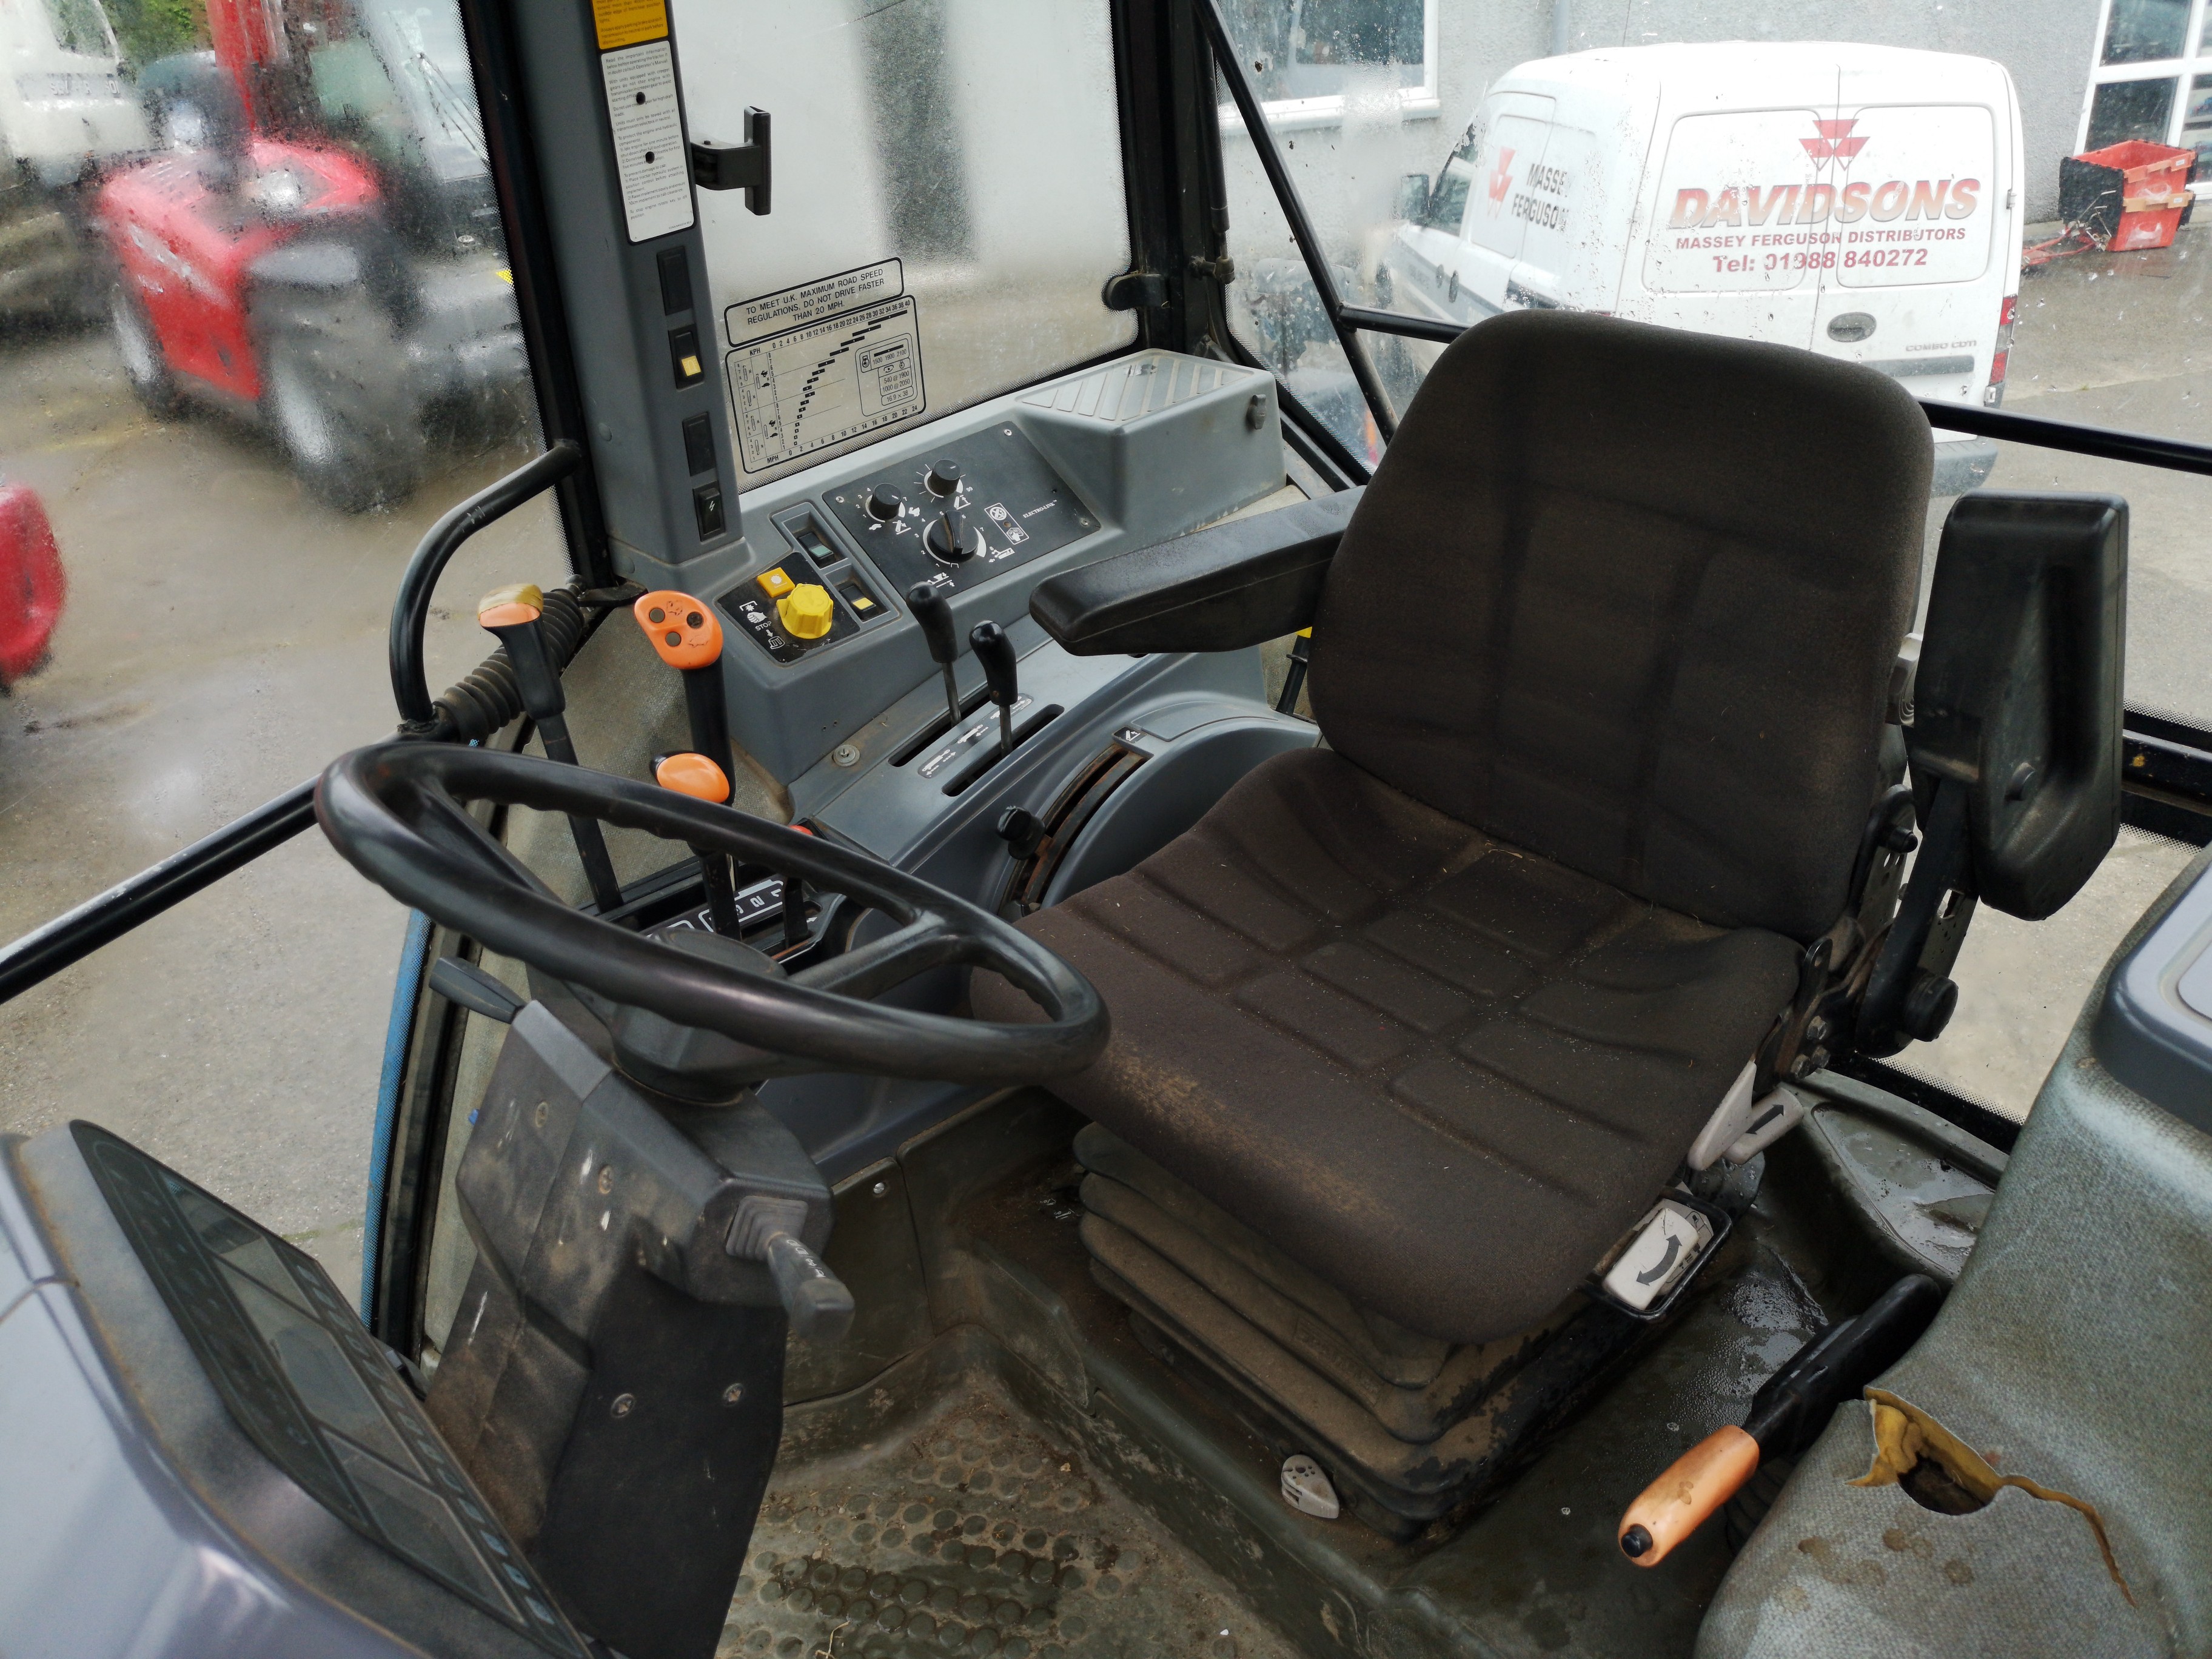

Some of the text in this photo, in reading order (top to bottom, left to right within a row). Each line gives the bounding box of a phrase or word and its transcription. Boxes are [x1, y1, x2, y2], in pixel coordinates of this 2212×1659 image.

[1526, 164, 1569, 196] MASSE
[1667, 178, 1981, 230] DAVIDSONS
[1676, 228, 1966, 249] MASSEY FERGUSON DISTRIBUTORS
[1714, 248, 1928, 273] Tel: 01988 840272
[746, 269, 883, 315] TO MEET U.K. MAXIMUM ROAD SPEED
[748, 278, 884, 325] REGULATIONS, DO NOT DRIVE FASTER
[793, 300, 845, 321] THAN 20 MPH.
[749, 347, 760, 356] KPH
[1906, 343, 1949, 352] COMBO
[899, 378, 910, 387] 2050
[767, 455, 779, 463] MPH
[756, 621, 772, 631] STOP
